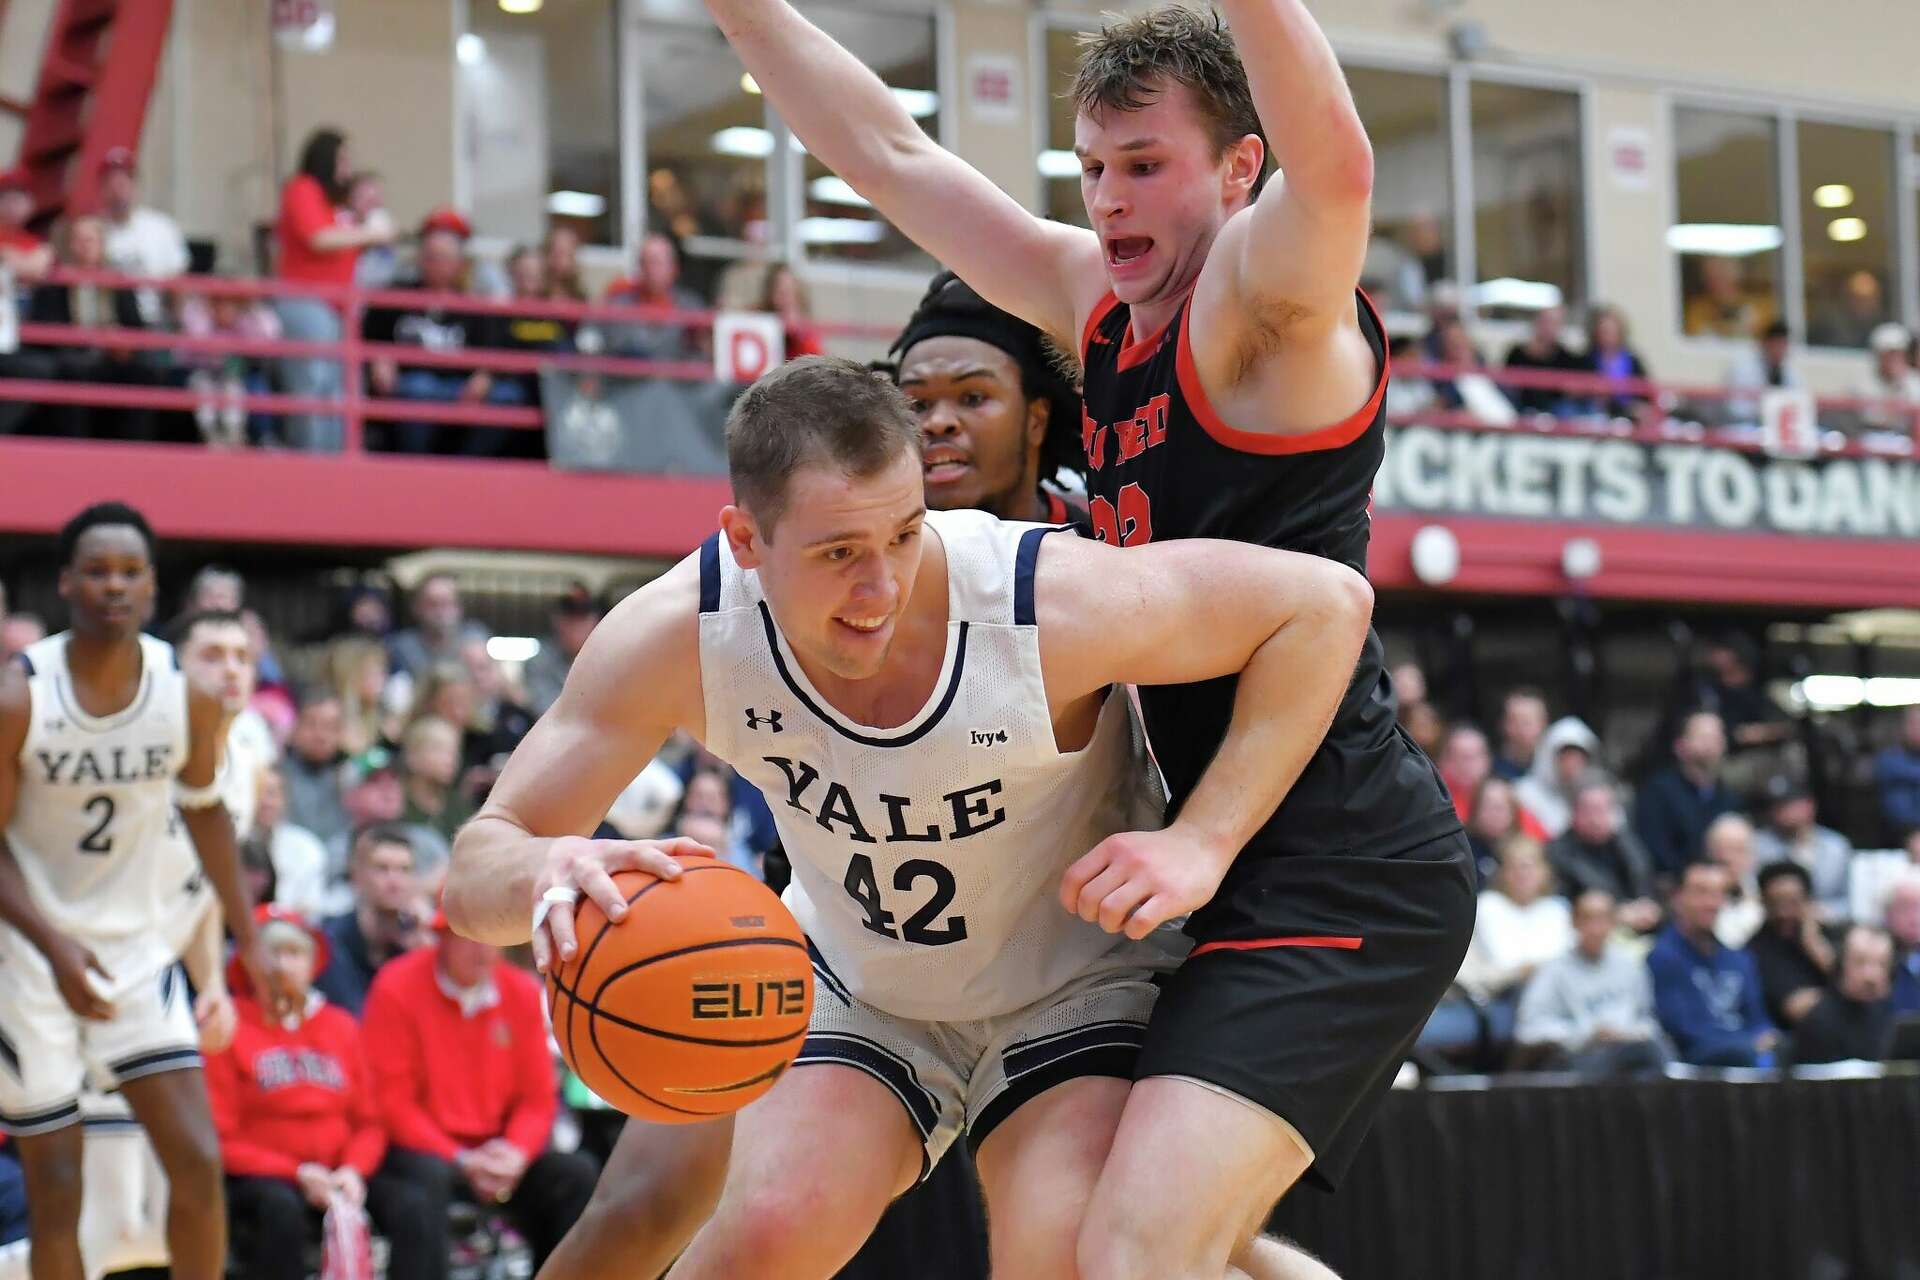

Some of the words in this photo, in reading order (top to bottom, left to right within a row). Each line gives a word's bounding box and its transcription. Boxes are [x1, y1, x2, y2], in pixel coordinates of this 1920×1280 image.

[731, 330, 768, 382] D
[1659, 445, 1759, 529] TO
[37, 744, 174, 785] YALE
[970, 730, 995, 748] Ivy
[79, 794, 115, 854] 2
[762, 756, 1006, 843] YALE
[844, 853, 968, 946] 42
[692, 979, 805, 1019] ELITE
